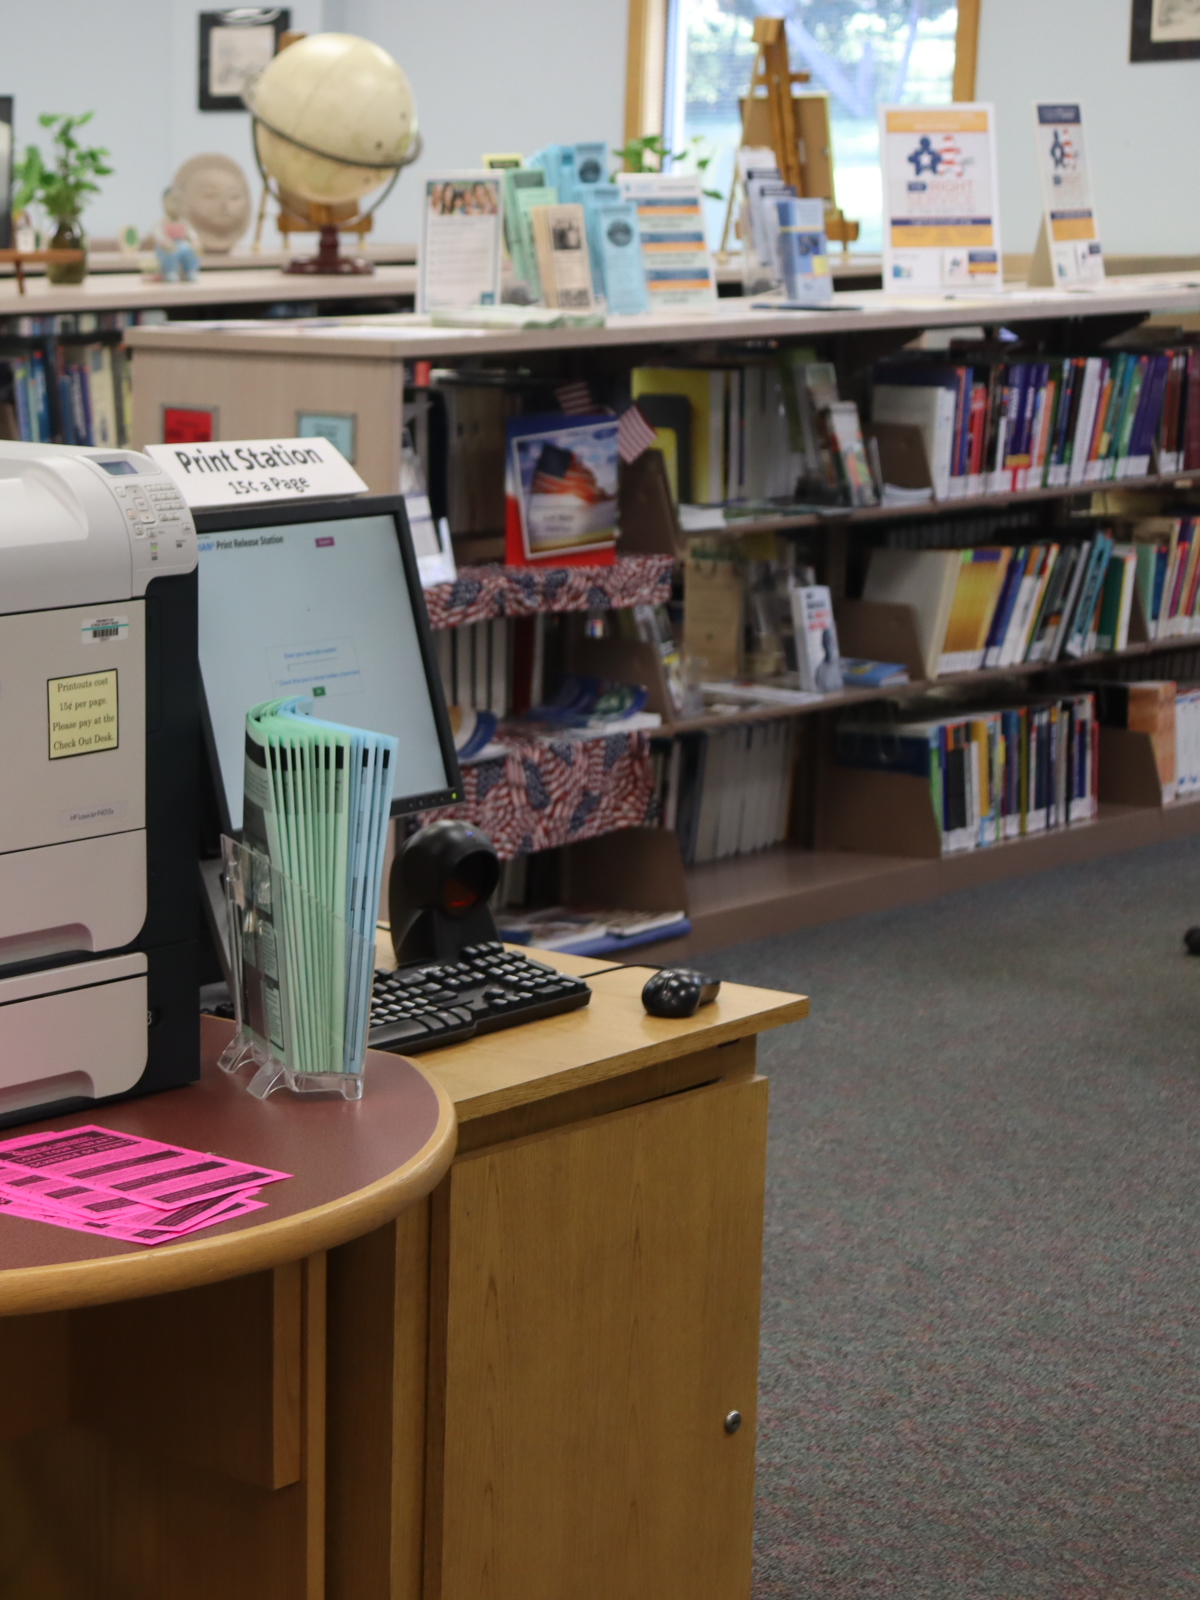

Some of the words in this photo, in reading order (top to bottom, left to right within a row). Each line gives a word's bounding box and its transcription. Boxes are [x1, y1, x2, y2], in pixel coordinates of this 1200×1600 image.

[174, 448, 239, 474] Print
[234, 444, 324, 471] Station
[260, 481, 272, 491] a
[270, 477, 310, 493] Page
[216, 540, 233, 550] Print
[234, 538, 259, 548] Release
[259, 535, 284, 546] Station
[57, 681, 92, 692] Printouts
[94, 677, 108, 686] cost
[60, 702, 73, 711] 15¢
[75, 701, 87, 711] per
[89, 698, 108, 708] page.
[53, 721, 77, 731] Please
[79, 719, 92, 729] pay
[103, 714, 115, 723] the
[53, 738, 76, 750] Check
[78, 737, 92, 746] Out
[94, 732, 114, 743] Desk.
